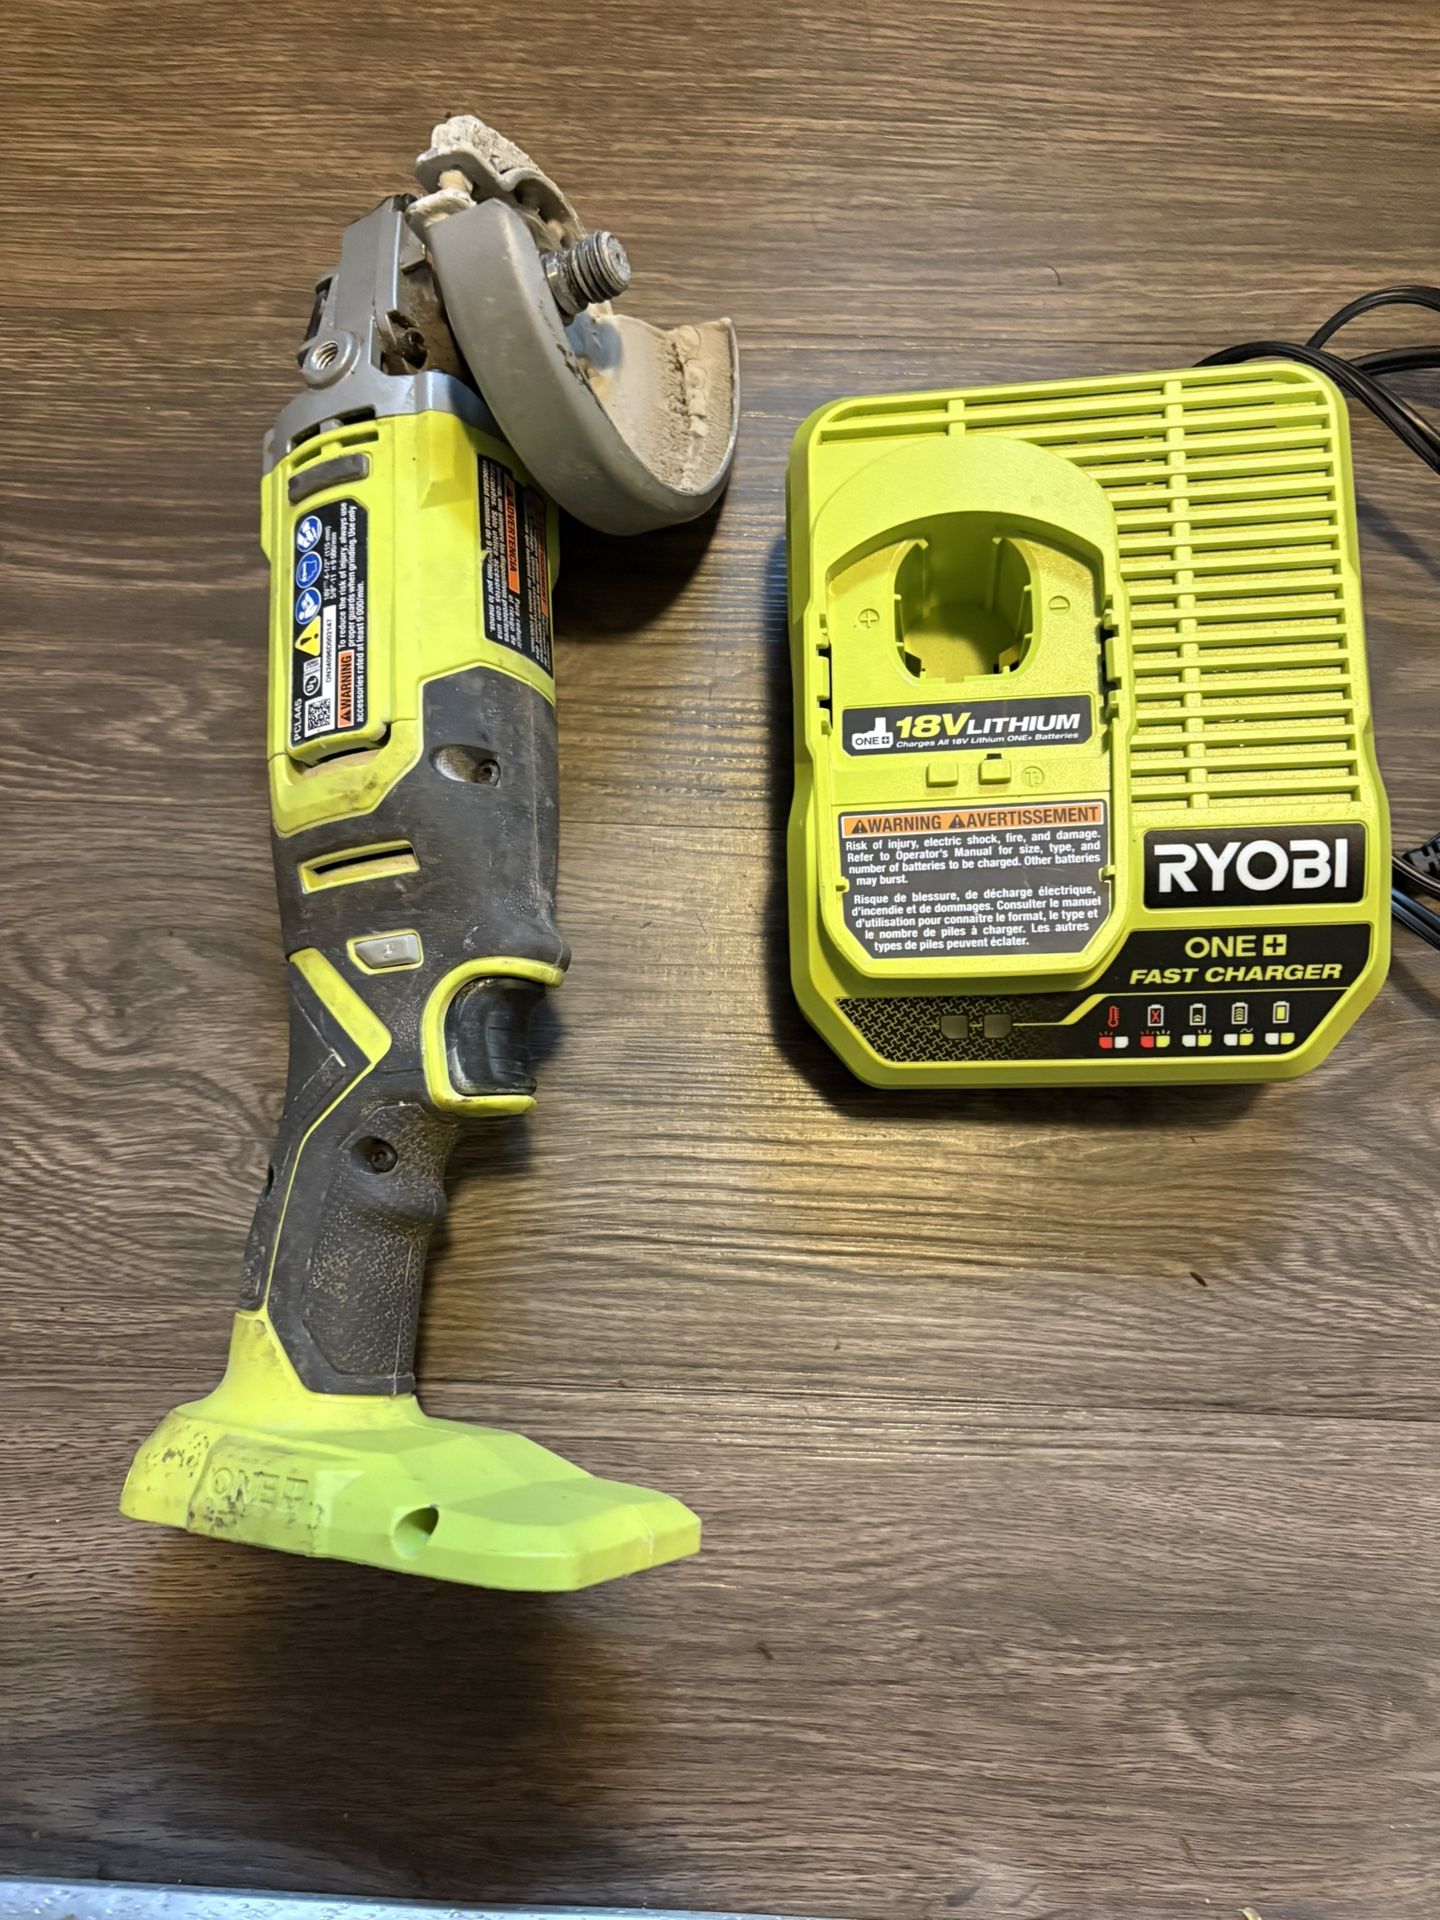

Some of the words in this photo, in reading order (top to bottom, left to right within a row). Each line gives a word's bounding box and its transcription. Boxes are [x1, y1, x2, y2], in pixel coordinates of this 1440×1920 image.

[349, 506, 357, 521] only
[340, 518, 348, 543] always
[348, 523, 356, 536] Use
[485, 529, 492, 538] de
[507, 497, 517, 572] ADVERTENCIA
[339, 545, 348, 569] injury,
[348, 538, 357, 570] grinding.
[488, 595, 495, 603] lo
[488, 604, 496, 632] menos.
[356, 623, 364, 641] least
[511, 635, 516, 645] de
[338, 641, 346, 649] To
[356, 653, 364, 673] rated
[341, 655, 352, 709] WARNING
[356, 675, 364, 722] accessories
[294, 698, 302, 741] PCL445
[896, 740, 935, 748] Charges
[937, 738, 949, 746] All
[970, 736, 1005, 744] Lithium
[1007, 734, 1033, 742] ONE+
[1035, 732, 1078, 740] Batteries
[868, 815, 941, 832] WARNING
[966, 806, 1099, 828] AVERTISSEMENT
[846, 840, 868, 851] Risk
[872, 840, 882, 850] of
[888, 838, 919, 850] injury,
[924, 836, 962, 848] electric
[967, 834, 1000, 846] shock,
[1006, 832, 1026, 844] fire,
[1031, 831, 1050, 841] and
[1056, 829, 1101, 841] damage.
[848, 852, 874, 863] Refer
[880, 852, 890, 861] to
[896, 848, 948, 862] Operator's
[954, 846, 992, 857] Manual
[998, 844, 1013, 855] for
[1019, 844, 1043, 854] size,
[1049, 842, 1075, 854] type,
[1080, 841, 1100, 851] and
[849, 862, 887, 874] number
[889, 862, 899, 872] of
[902, 860, 946, 872] batteries
[949, 859, 958, 869] to
[962, 858, 975, 868] be
[977, 856, 1021, 870] charged.
[1024, 856, 1053, 866] Other
[1055, 852, 1100, 865] batteries
[1154, 838, 1348, 893] RYOBI
[856, 876, 878, 888] may
[880, 874, 908, 885] burst.
[852, 903, 904, 916] d'incendie
[906, 903, 917, 914] et
[919, 902, 932, 913] de
[934, 900, 994, 914] dommages.
[996, 898, 1046, 911] Consulter
[1050, 898, 1059, 908] le
[1062, 896, 1101, 908] manuel
[854, 894, 889, 906] Risque
[894, 892, 907, 903] de
[912, 890, 960, 904] blessure,
[965, 889, 978, 900] de
[984, 887, 1033, 900] décharge
[1038, 885, 1096, 898] électrique,
[856, 916, 916, 928] d'utilisation
[918, 915, 942, 927] pour
[944, 912, 993, 924] connaître
[996, 912, 1005, 922] le
[1008, 910, 1047, 923] format,
[1049, 910, 1058, 920] le
[1062, 909, 1085, 921] type
[1088, 908, 1098, 918] et
[865, 929, 874, 940] le
[879, 928, 918, 939] nombre
[923, 926, 936, 938] de
[941, 926, 966, 938] piles
[971, 925, 978, 936] à
[983, 924, 1026, 937] charger.
[1031, 922, 1050, 932] Les
[1055, 922, 1089, 932] autres
[874, 940, 902, 952] types
[904, 939, 917, 950] de
[920, 938, 944, 951] piles
[946, 937, 988, 950] peuvent
[990, 935, 1029, 946] éclater.
[1129, 968, 1199, 985] FAST
[1205, 964, 1342, 983] CHARGER
